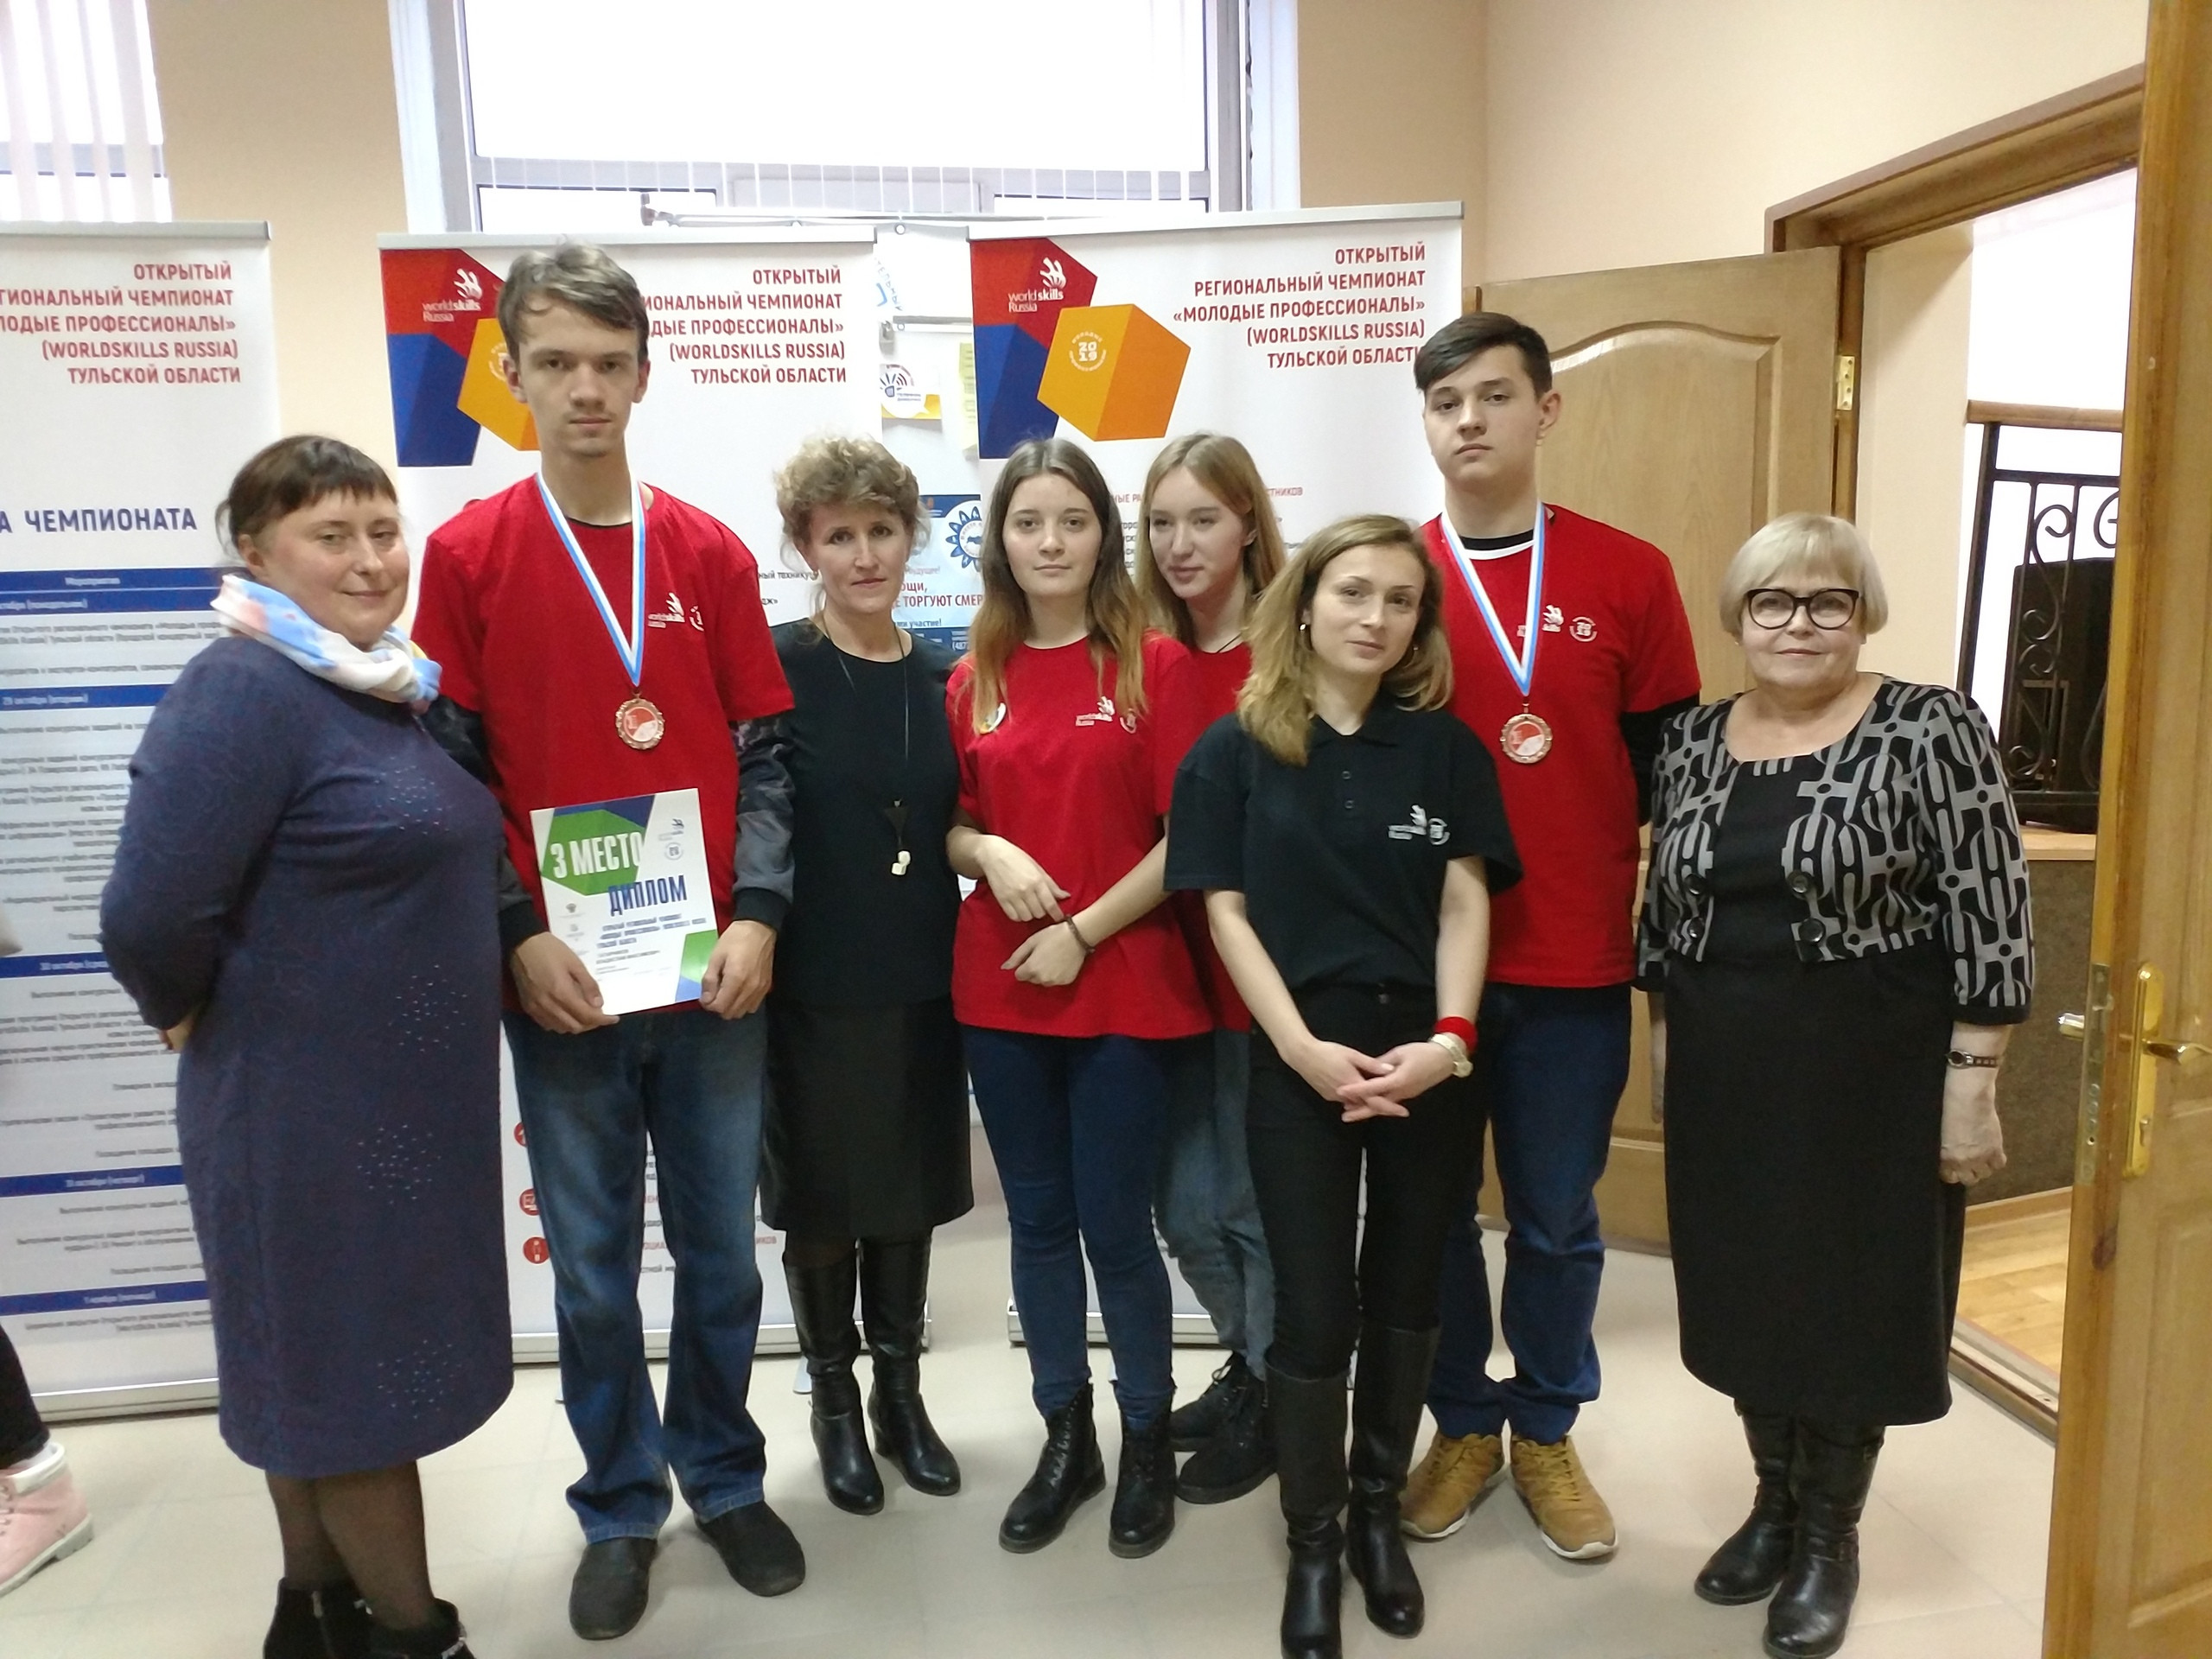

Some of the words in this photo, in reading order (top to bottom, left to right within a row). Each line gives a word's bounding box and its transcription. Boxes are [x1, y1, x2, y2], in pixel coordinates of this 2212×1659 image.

[1335, 241, 1426, 264] ОТКРЫТЫЙ
[134, 261, 232, 281] ОТКРЫТЫЙ
[753, 265, 842, 285] ОТКРЫТЫЙ
[1194, 271, 1323, 297] РЕГИОНАЛЬНЫЙ
[1328, 270, 1426, 291] ЧЕМПИОНАТ
[128, 289, 234, 306] ЧЕМПИОНАТ
[747, 294, 842, 310] ЧЕМПИОНАТ
[1008, 302, 1038, 313] Russia
[1173, 303, 1265, 323] «МОЛОДЫЕ
[1270, 296, 1425, 319] ПРОФЕССИОНАЛЫ»
[66, 315, 236, 334] ПРОФЕССИОНАЛЫ»
[691, 318, 843, 335] ПРОФЕССИОНАЛЫ»
[1247, 324, 1359, 346] (WORLDSKILLS
[1364, 318, 1425, 339] RUSSIA)
[42, 340, 169, 360] (WORLDSKILLS
[175, 339, 238, 359] RUSSIA)
[670, 342, 780, 362] (WORLDSKILLS
[785, 340, 845, 359] RUSSIA)
[1268, 346, 1348, 369] ТУЛЬСКОЙ
[67, 363, 159, 385] ТУЛЬСКОЙ
[164, 366, 241, 384] ОБЛАСТИ
[691, 364, 772, 385] ТУЛЬСКОЙ
[776, 367, 847, 383] ОБЛАСТИ
[24, 507, 197, 532] ЧЕМПИОНАТА
[903, 594, 952, 607] ТОРГУЮТ
[550, 842, 568, 879] 3
[569, 831, 644, 876] МЕСТО
[607, 874, 688, 917] ДИПЛОМ
